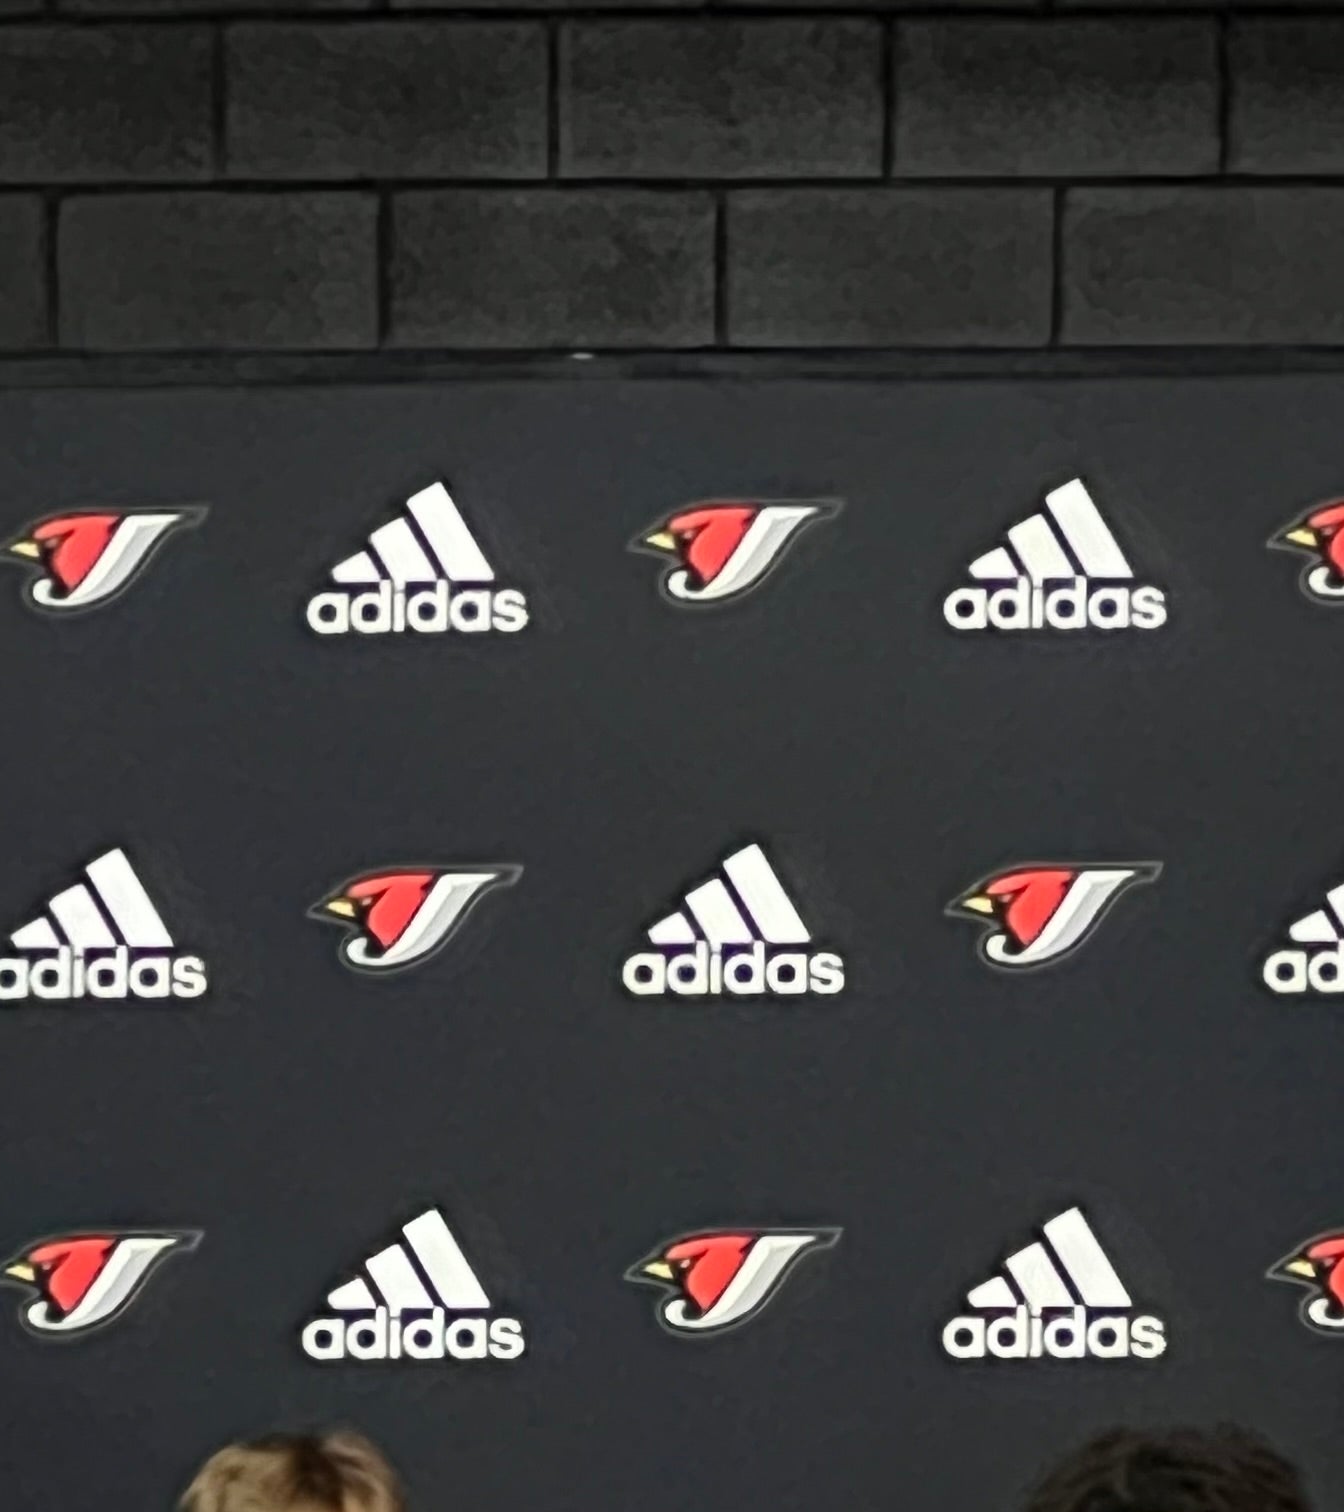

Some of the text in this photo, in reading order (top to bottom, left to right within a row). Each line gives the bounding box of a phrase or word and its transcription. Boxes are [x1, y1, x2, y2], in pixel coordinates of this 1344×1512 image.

[306, 580, 529, 634] adidas
[943, 575, 1167, 629] adidas
[623, 942, 844, 996] adidas
[302, 1307, 525, 1361] adidas
[942, 1305, 1167, 1359] adidas
